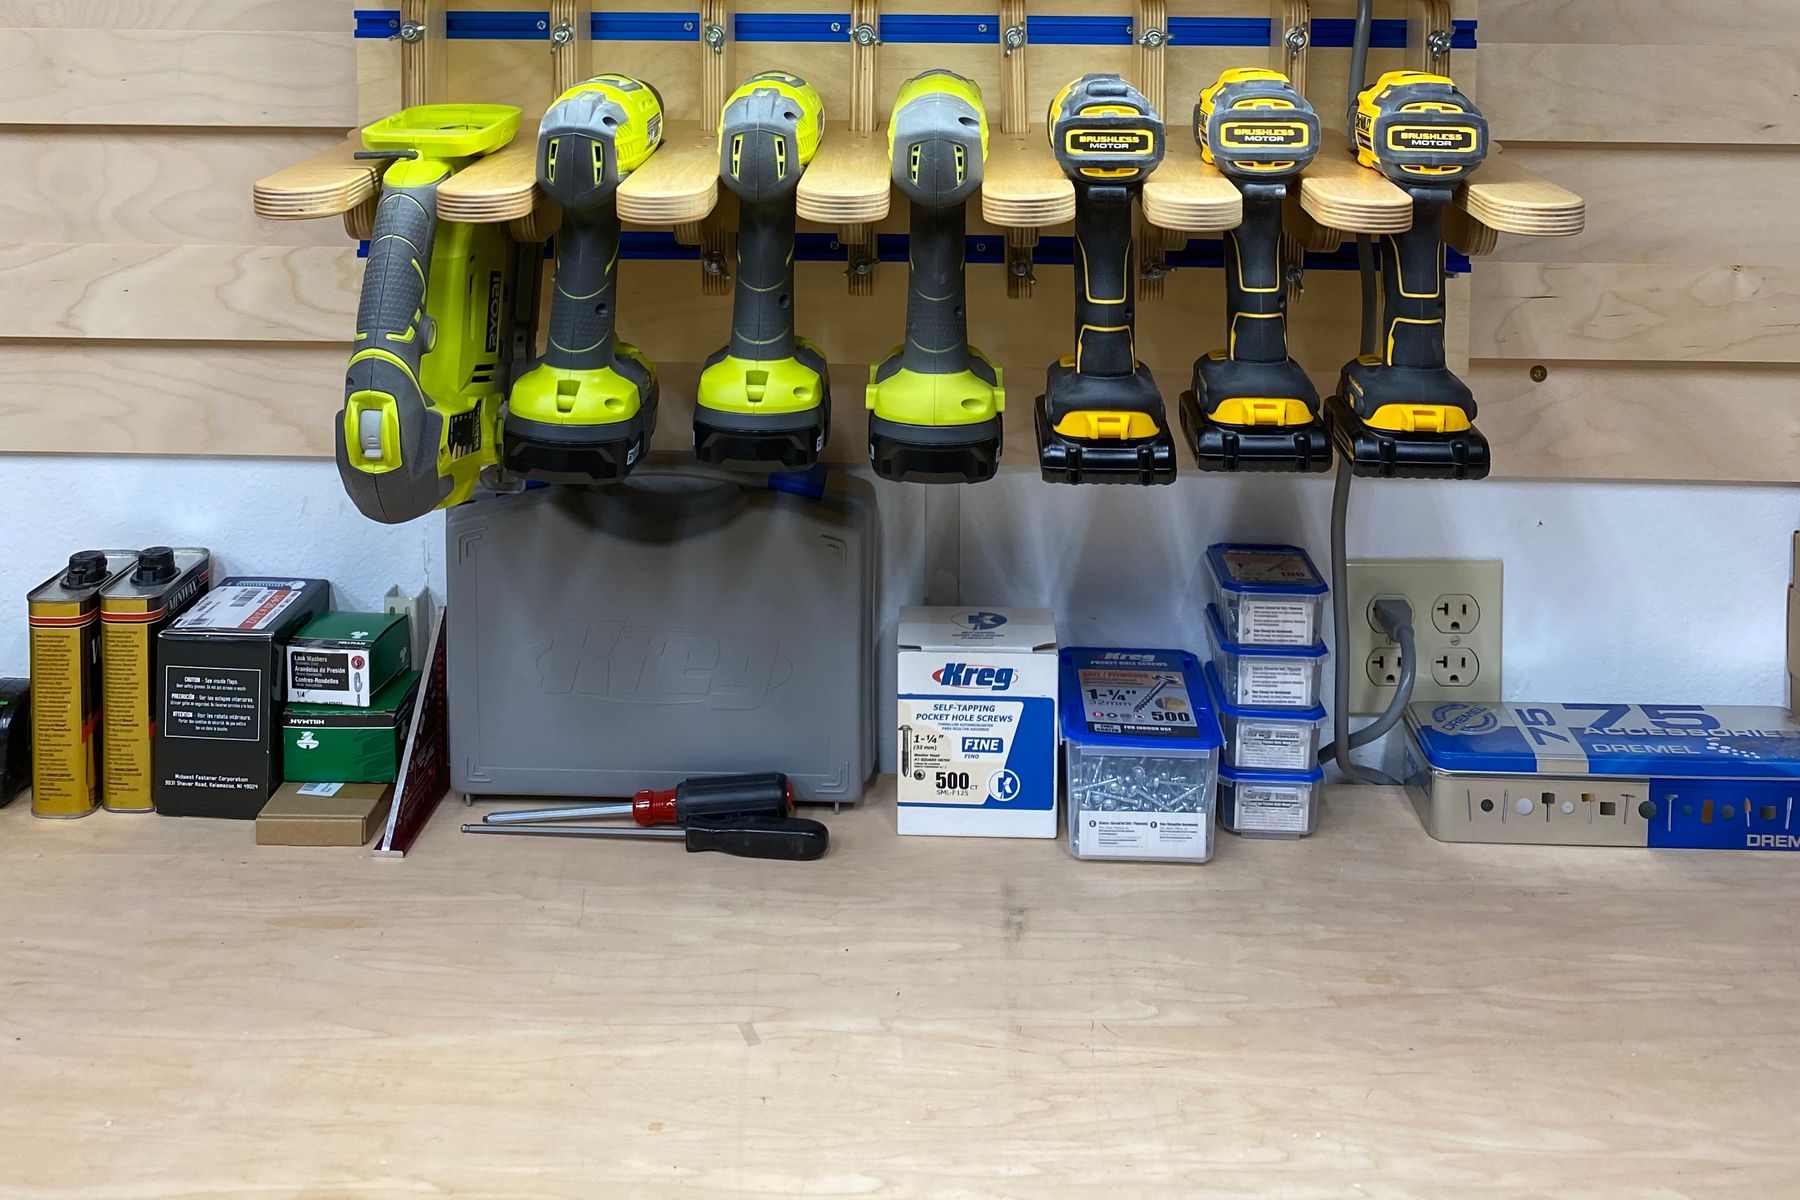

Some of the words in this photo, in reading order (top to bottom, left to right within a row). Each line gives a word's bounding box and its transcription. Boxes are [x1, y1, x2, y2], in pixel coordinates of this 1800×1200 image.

[1234, 128, 1295, 136] BRUSHLESS
[1400, 132, 1462, 140] BRUSHLESS
[489, 276, 500, 350] RYOBI
[169, 580, 197, 610] MINWAX
[538, 619, 779, 711] Kreg
[1104, 652, 1155, 662] Kreg
[941, 663, 1014, 690] Kreg
[933, 704, 995, 712] SELF-TAPPING
[1151, 712, 1190, 722] 500
[1442, 706, 1487, 730] DREMEL
[1562, 704, 1721, 730] 75
[1515, 708, 1570, 746] 75
[964, 739, 999, 750] FINE
[1592, 744, 1702, 754] DREMEL
[936, 772, 969, 789] 500
